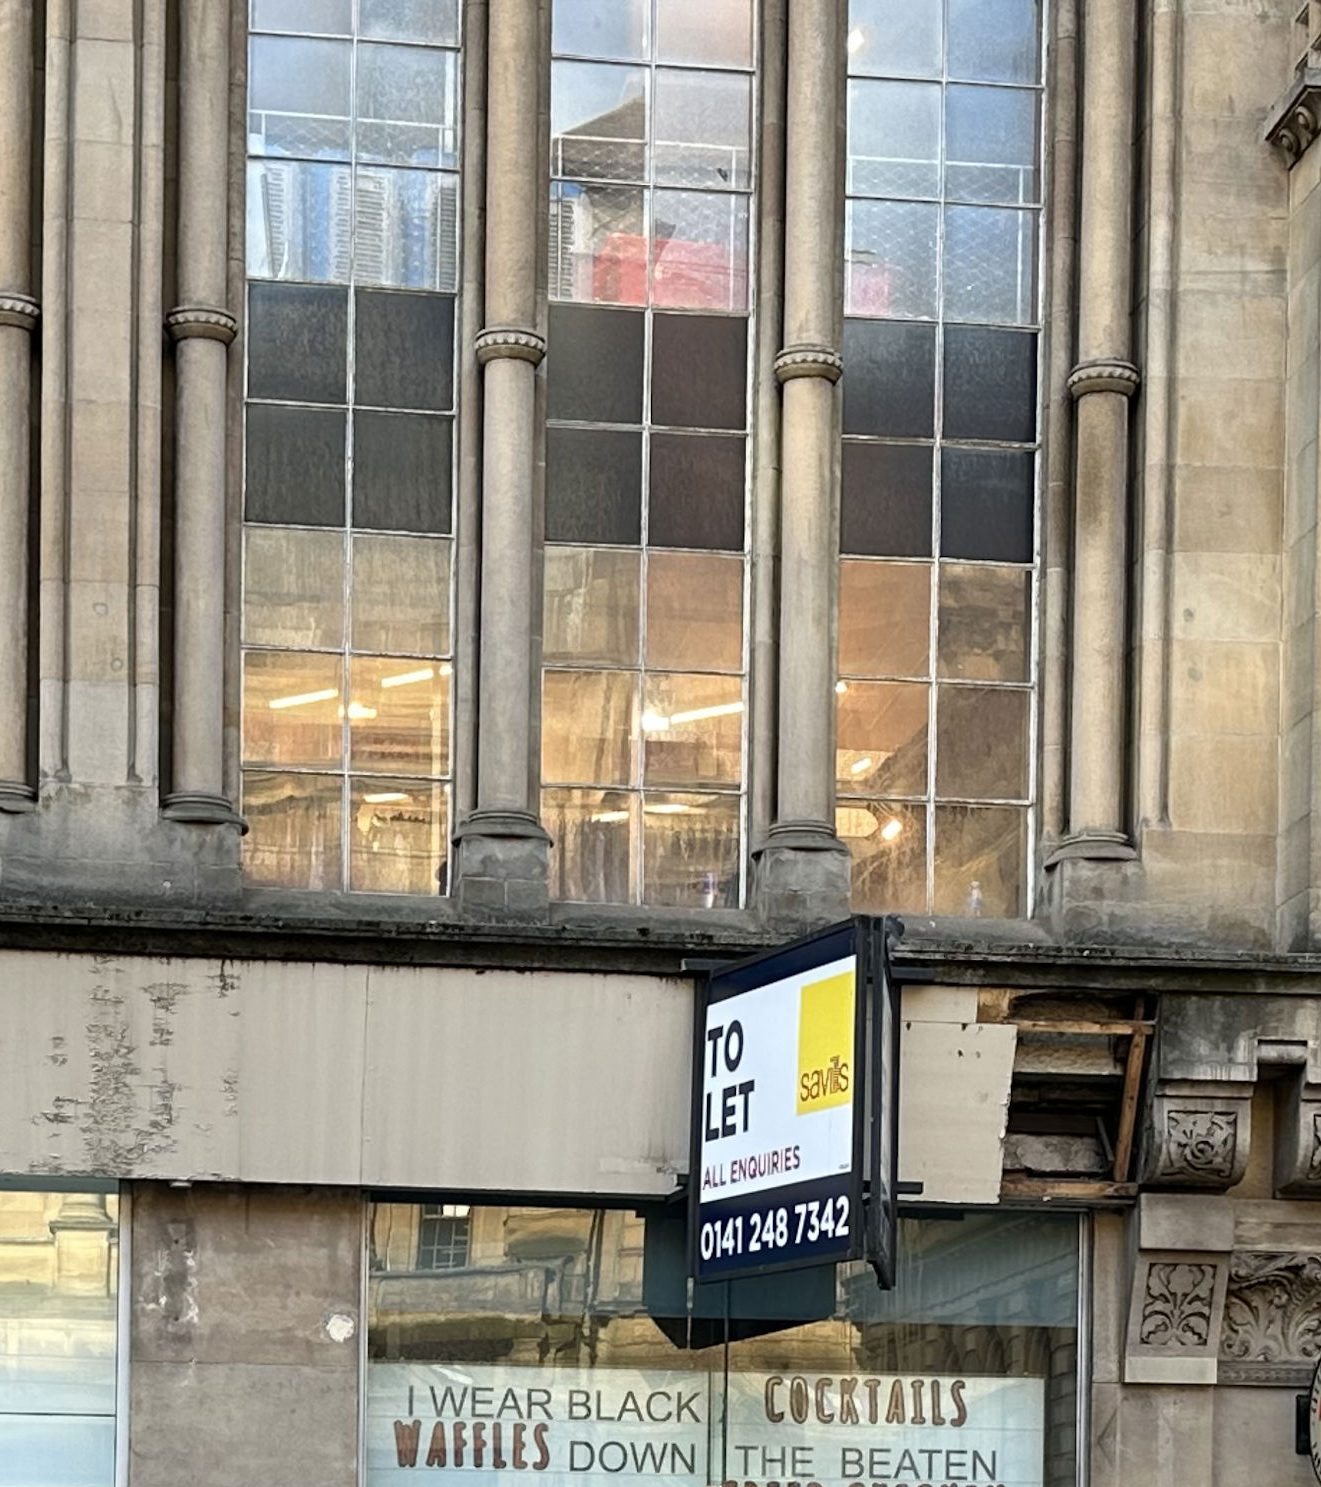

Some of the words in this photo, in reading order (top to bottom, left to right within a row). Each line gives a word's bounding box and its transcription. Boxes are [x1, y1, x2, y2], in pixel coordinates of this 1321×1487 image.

[707, 1019, 744, 1078] TO
[704, 1079, 755, 1142] LET
[702, 1164, 726, 1190] ALL
[730, 1144, 801, 1185] ENQUIRIES
[700, 1216, 744, 1260] 0141
[748, 1207, 789, 1254] 248
[793, 1195, 850, 1245] 7342
[407, 1386, 414, 1417] I
[430, 1386, 554, 1421] WEAR
[567, 1389, 703, 1424] BLACK
[764, 1376, 968, 1428] COCKTAILS
[393, 1419, 550, 1471] WAFFLES
[569, 1440, 696, 1474] DOWN
[734, 1445, 815, 1478] THE
[841, 1446, 997, 1481] BEATEN
